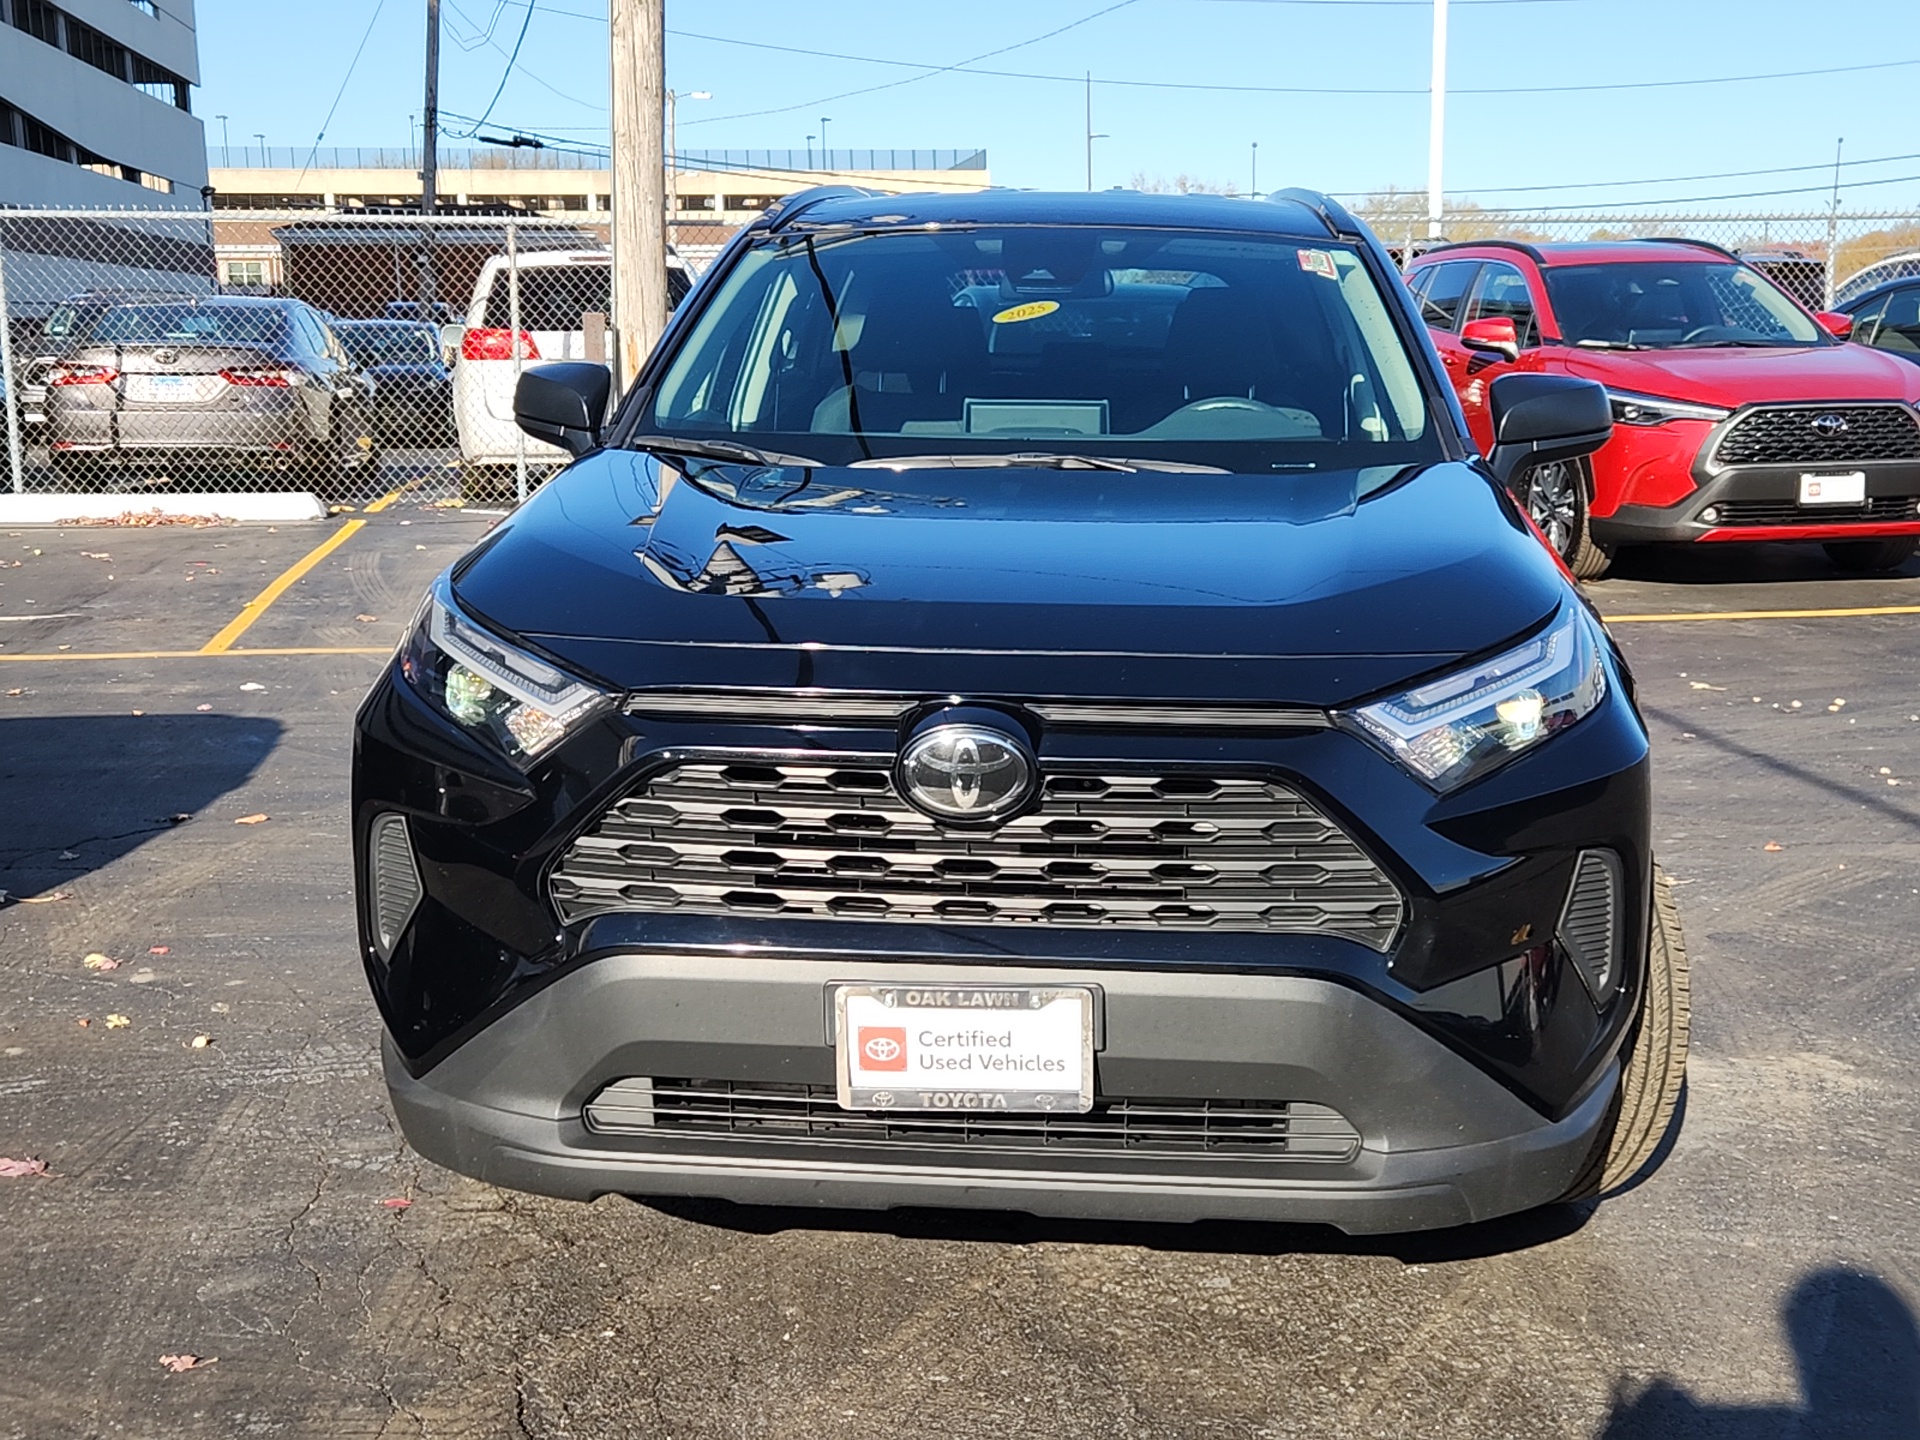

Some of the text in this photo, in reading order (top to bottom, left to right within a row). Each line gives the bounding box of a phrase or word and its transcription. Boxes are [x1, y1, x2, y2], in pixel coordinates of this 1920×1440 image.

[1007, 304, 1046, 320] 2025
[906, 991, 1020, 1008] OAK LAWN
[918, 1031, 1012, 1048] Certified
[919, 1054, 1066, 1072] Used Vehicles
[918, 1092, 1008, 1109] TOYOTA
